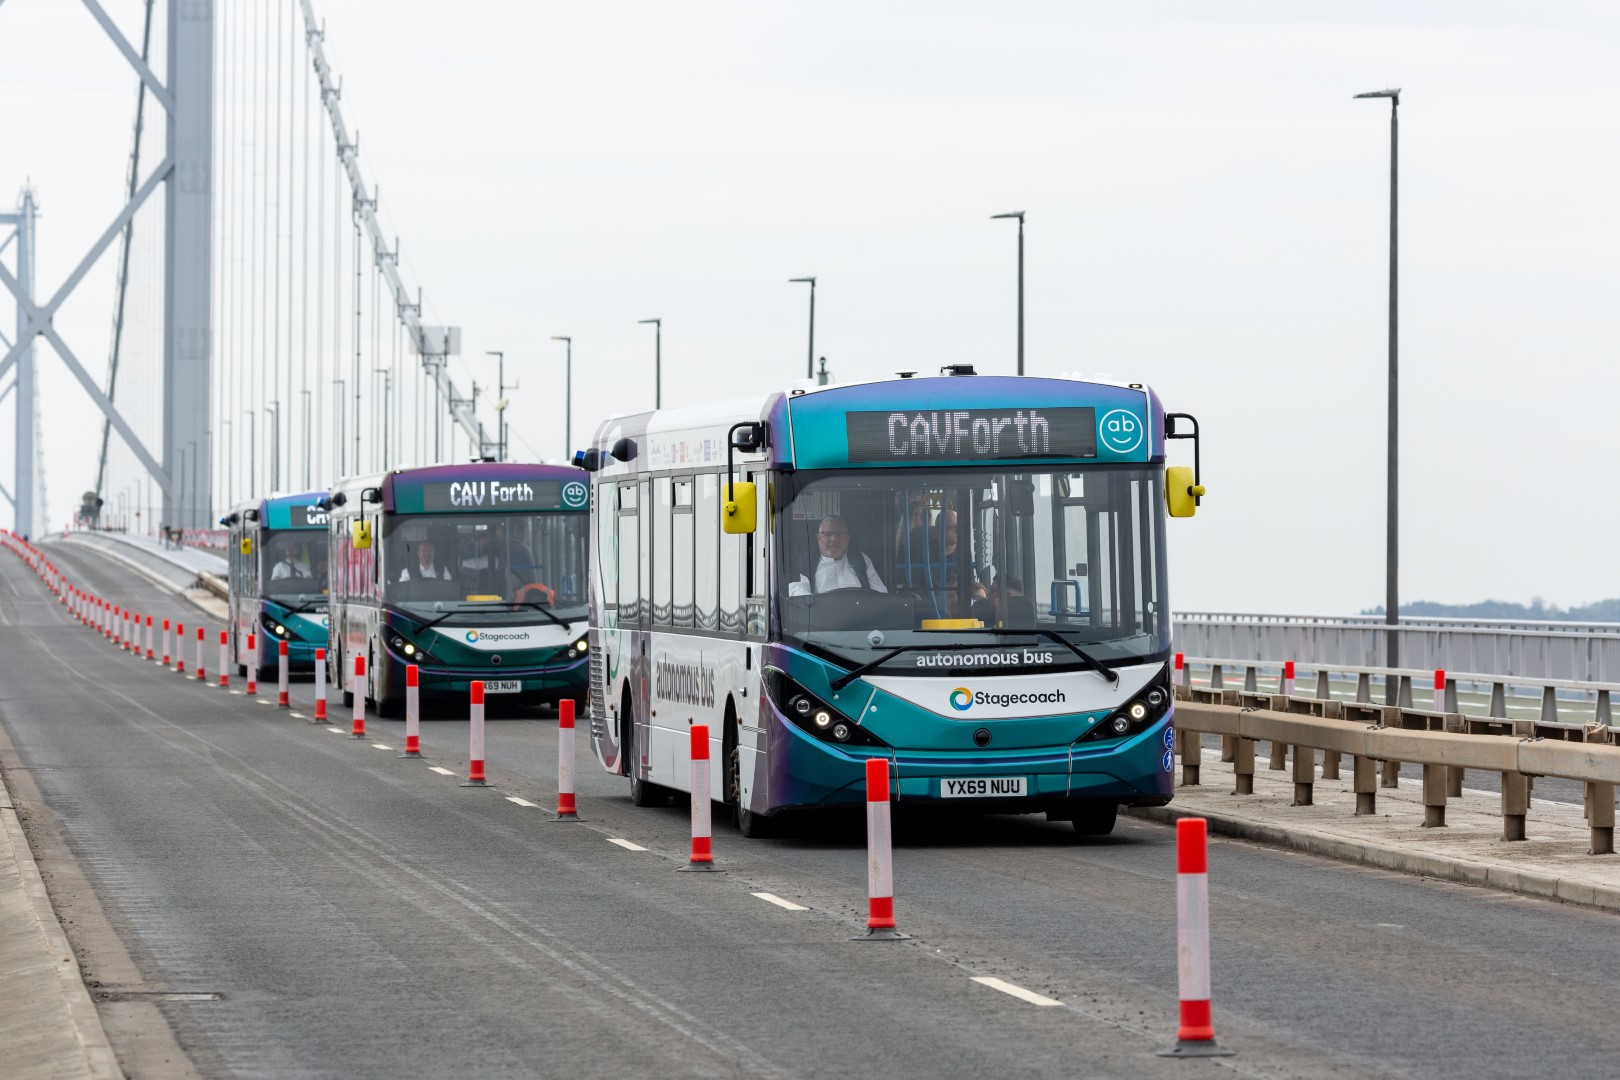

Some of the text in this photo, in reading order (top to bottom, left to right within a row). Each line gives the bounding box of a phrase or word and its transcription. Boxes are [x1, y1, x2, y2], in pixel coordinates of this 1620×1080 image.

[1107, 415, 1135, 433] ab
[450, 481, 533, 507] CAV Forth
[567, 486, 584, 496] ab
[479, 632, 530, 642] Stagecoach
[916, 649, 1053, 667] autonomous bus
[500, 681, 518, 690] NUH
[656, 649, 715, 709] autonomous bus
[974, 689, 1066, 708] Stagecoach
[947, 779, 1020, 795] YX69 NUU
